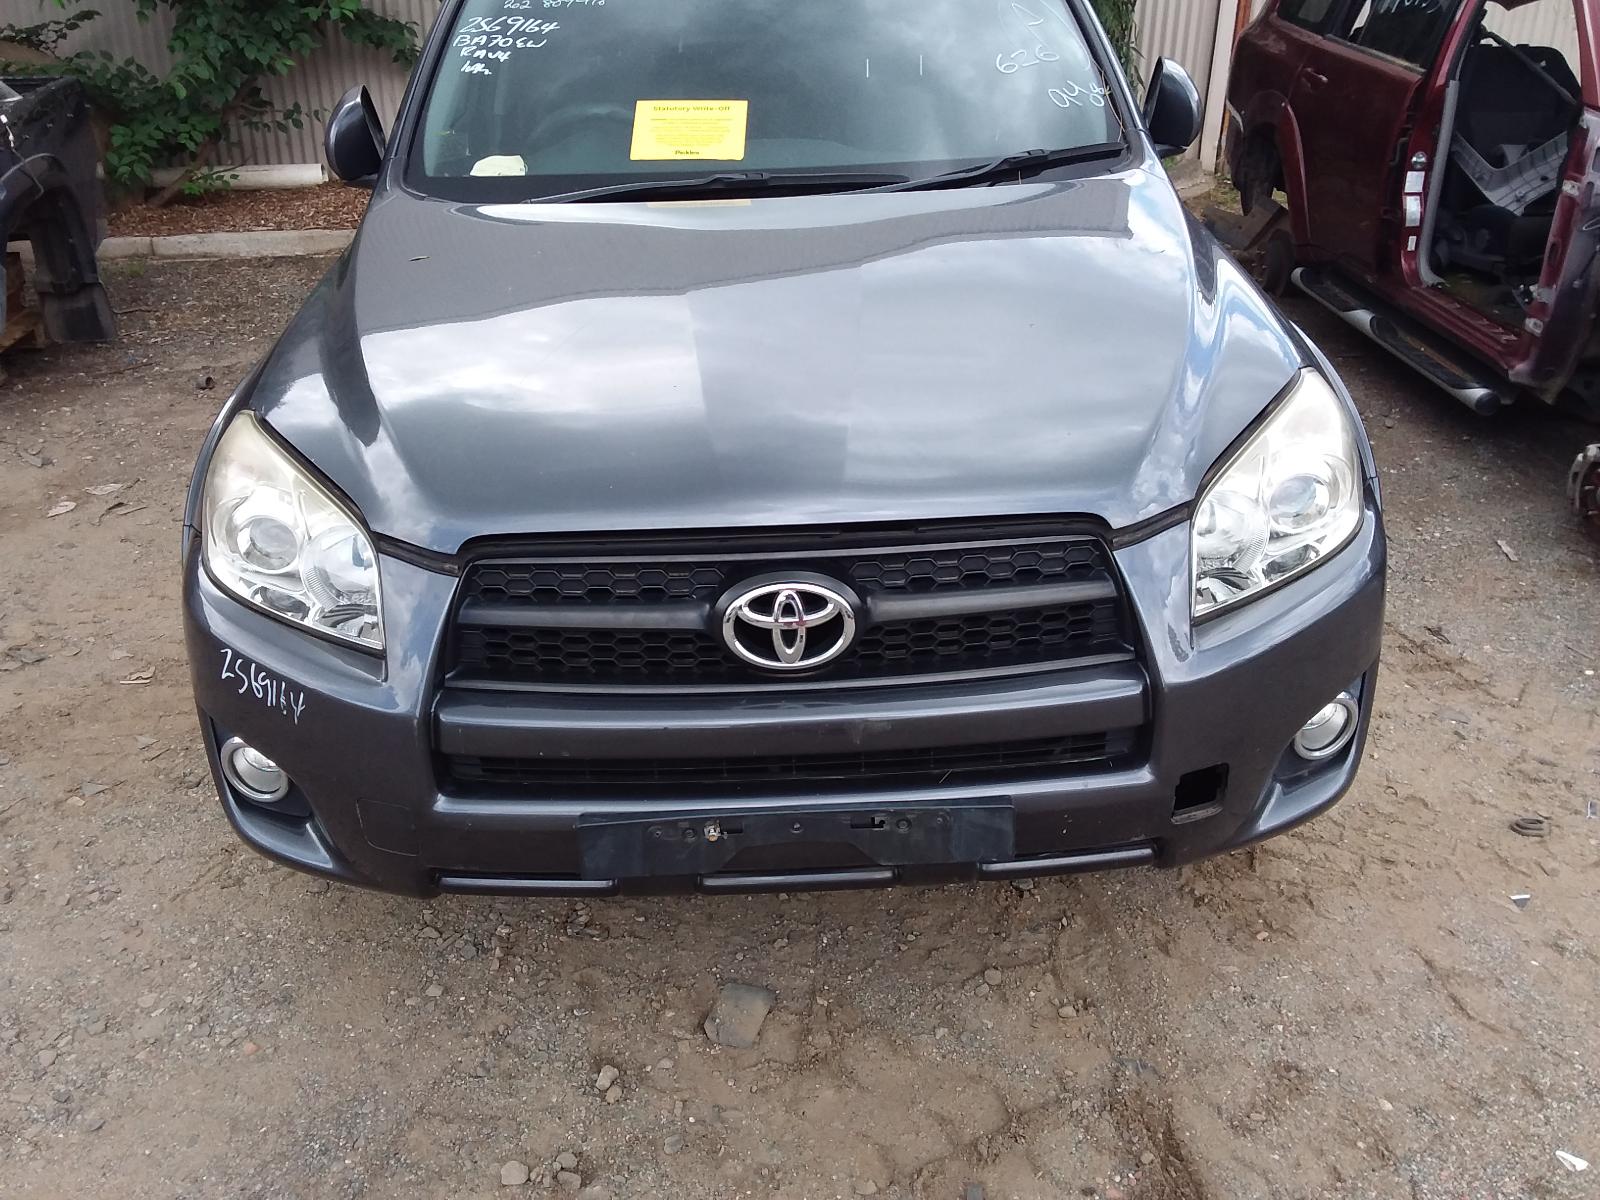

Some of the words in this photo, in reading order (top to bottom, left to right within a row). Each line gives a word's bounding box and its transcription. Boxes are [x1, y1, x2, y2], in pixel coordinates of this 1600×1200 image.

[459, 16, 560, 36] 2569164
[460, 46, 512, 62] RAV4
[995, 44, 1060, 74] 626
